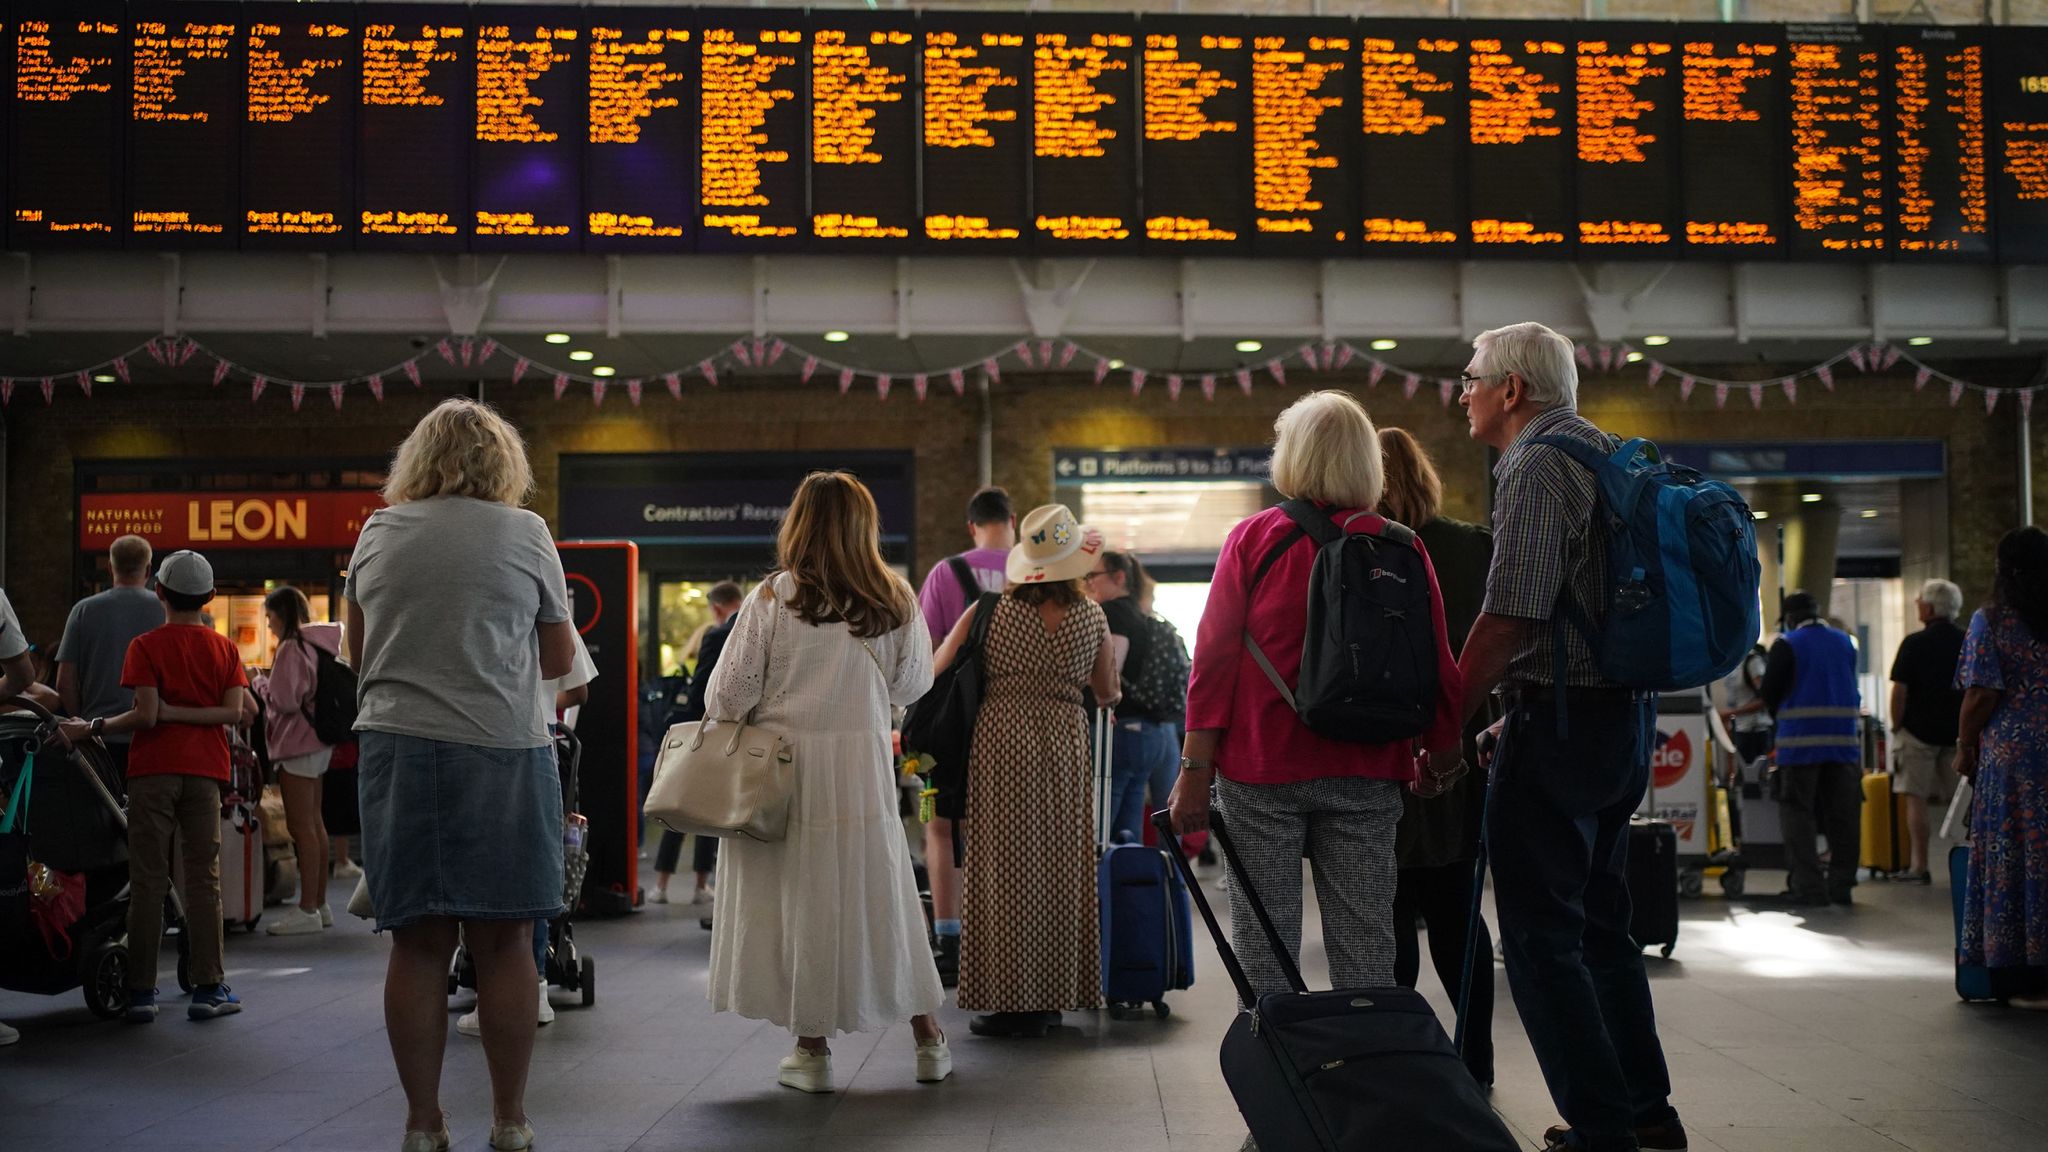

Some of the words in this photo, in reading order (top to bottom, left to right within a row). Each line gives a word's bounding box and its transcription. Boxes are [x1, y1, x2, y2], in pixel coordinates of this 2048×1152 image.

[1102, 458, 1176, 475] Platforms
[87, 509, 164, 521] NATURALLY
[189, 499, 307, 541] LEON
[643, 504, 740, 521] Contractors'
[88, 523, 119, 535] FAST
[125, 523, 162, 534] FOOD
